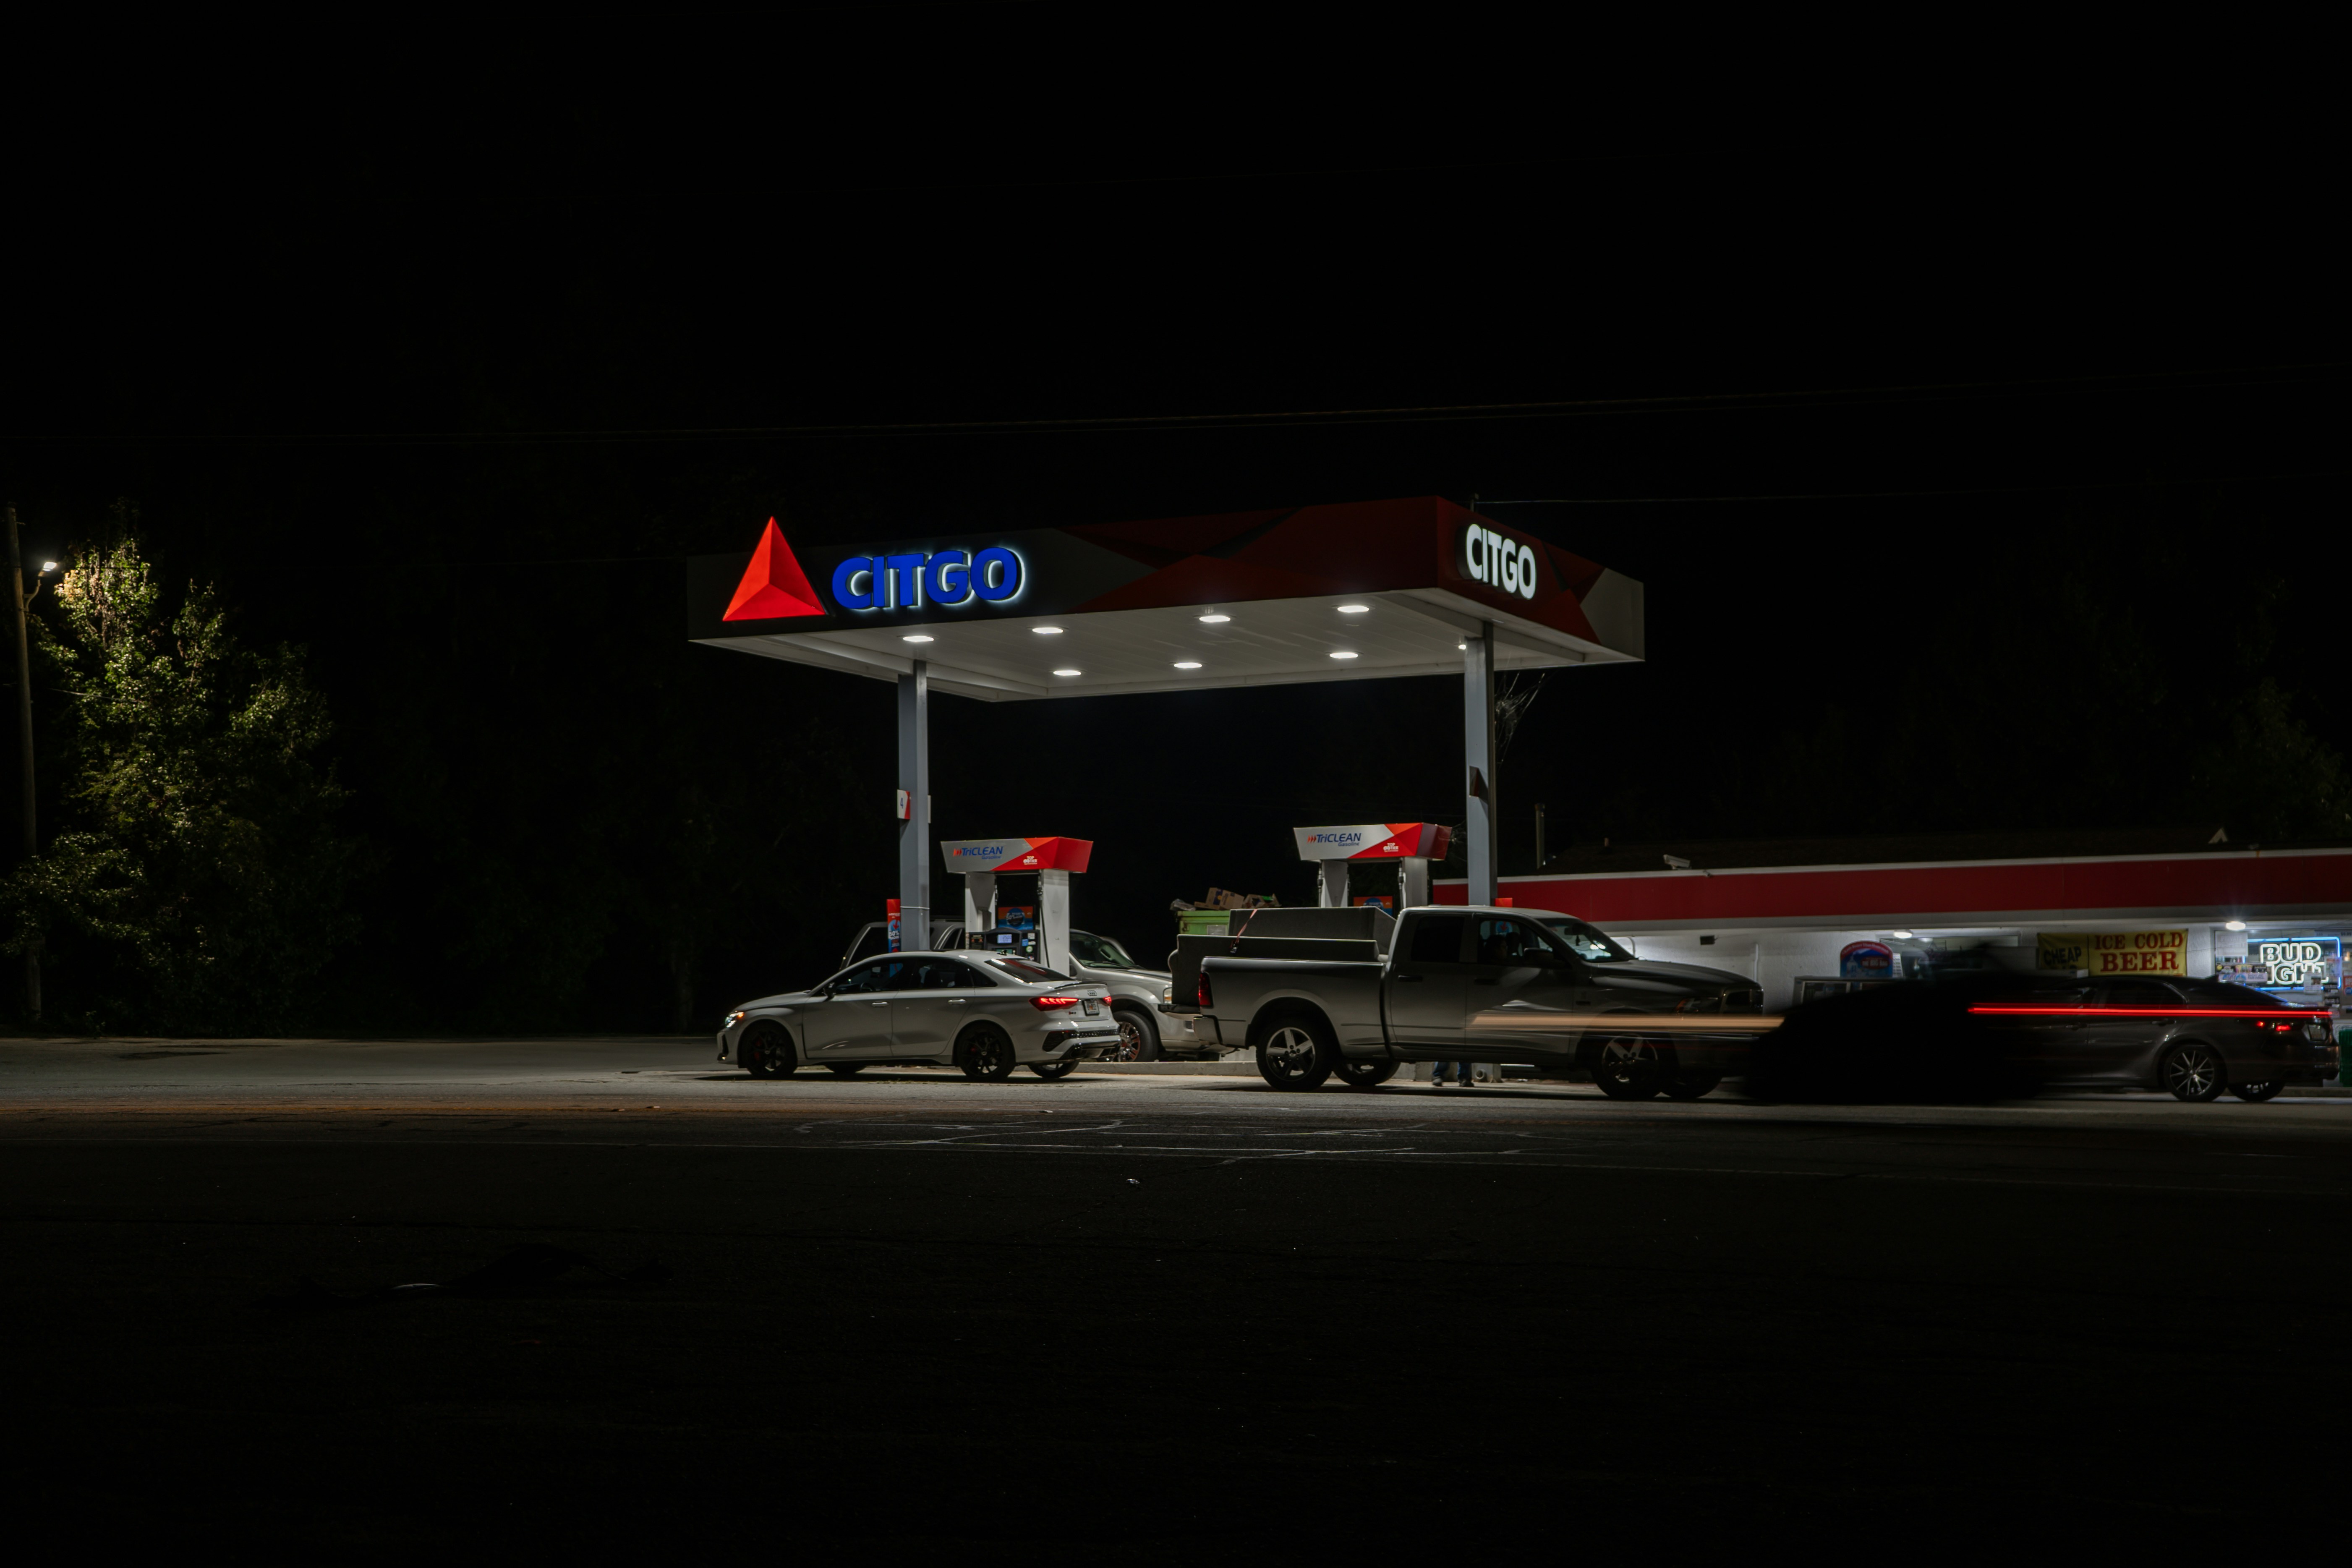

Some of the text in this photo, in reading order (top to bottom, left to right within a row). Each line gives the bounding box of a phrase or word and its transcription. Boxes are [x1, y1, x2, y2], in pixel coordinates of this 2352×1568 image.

[1466, 523, 1537, 600] CITGO
[831, 547, 1019, 609] CITGO
[1317, 833, 1361, 843] TriCLEAN
[962, 846, 1004, 856] TriCLEAN
[2094, 932, 2183, 950] ICE COLD
[2043, 946, 2082, 966] CHEAP
[2100, 951, 2179, 972] BEER
[2260, 942, 2322, 965] BUD
